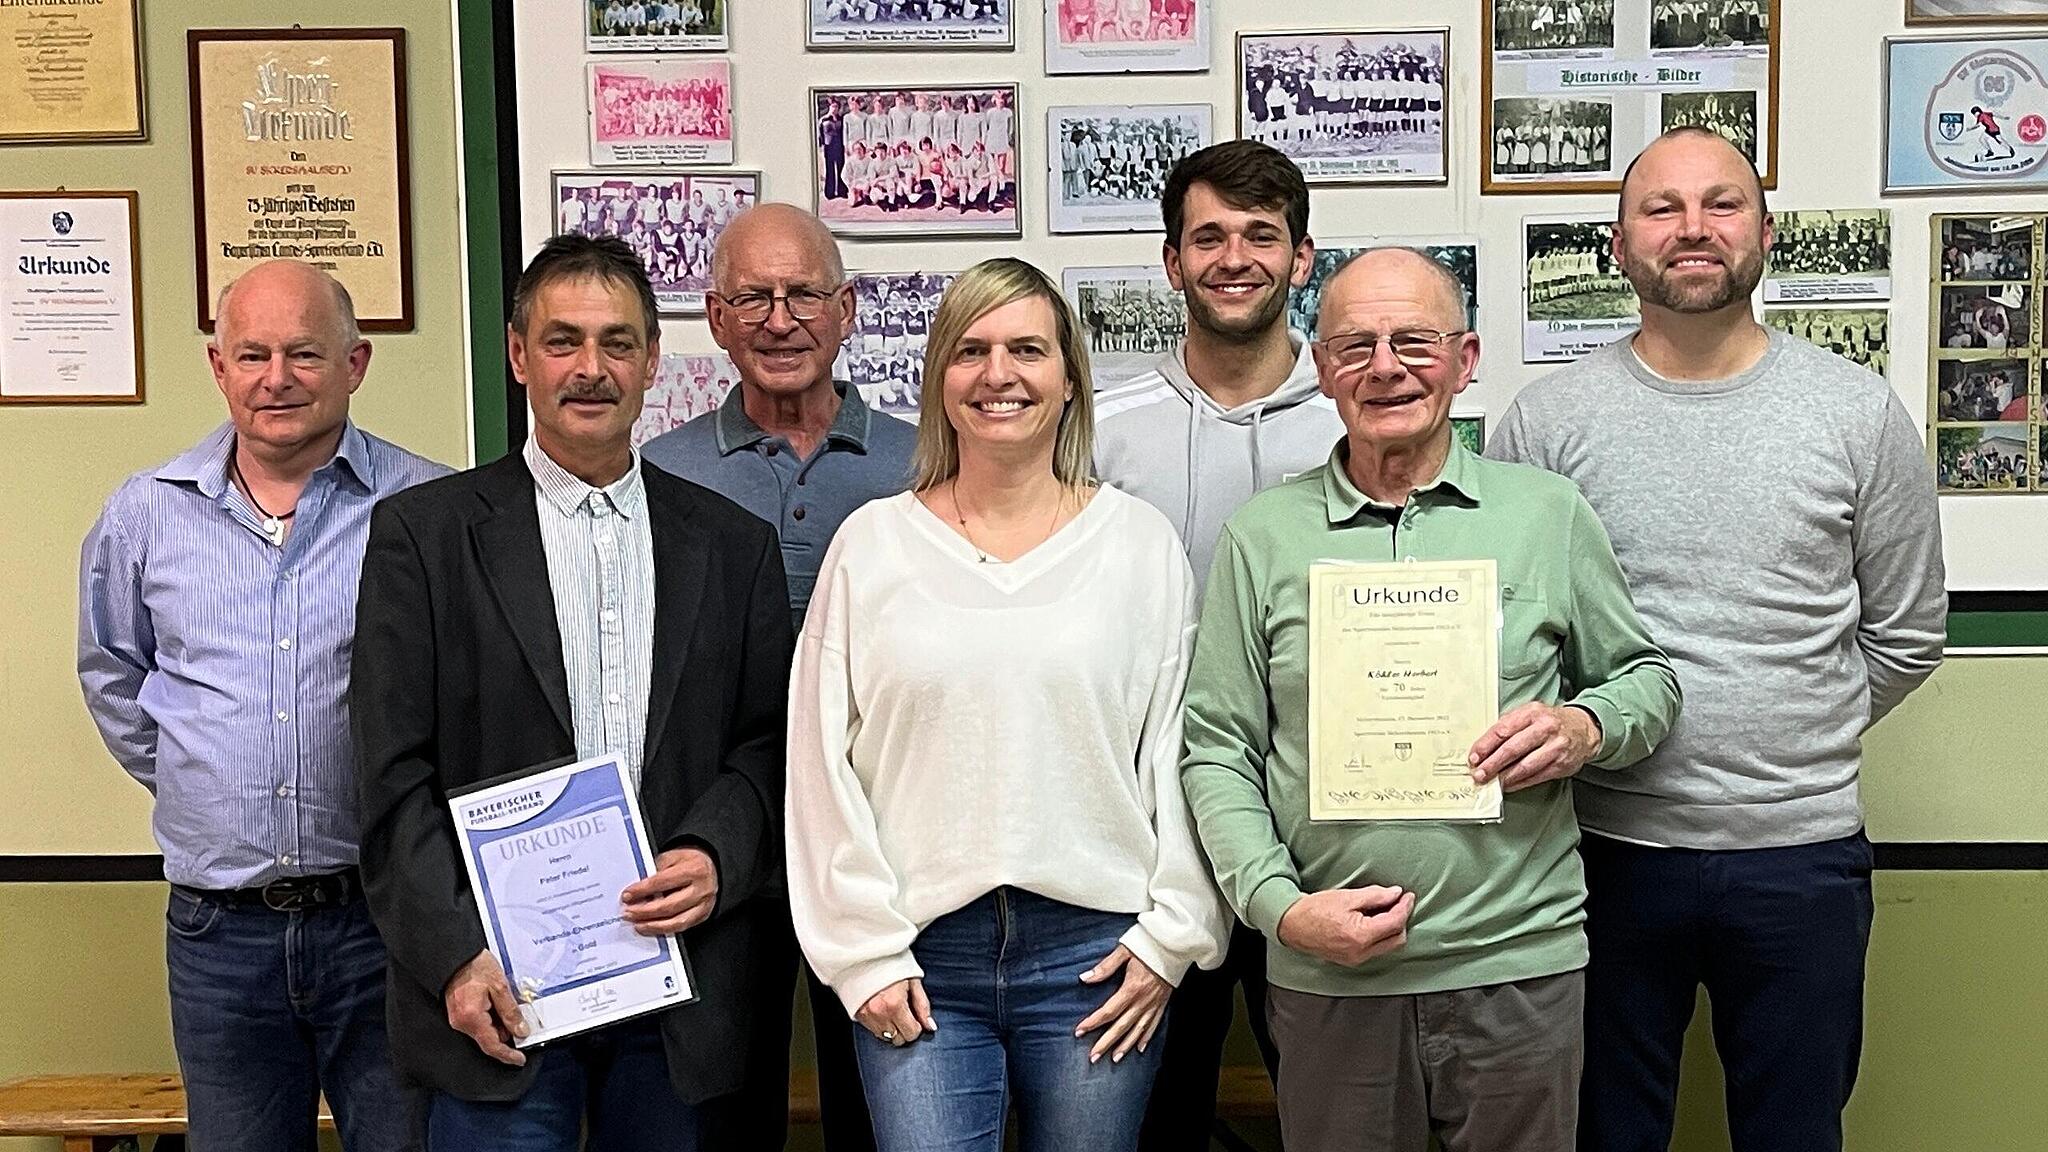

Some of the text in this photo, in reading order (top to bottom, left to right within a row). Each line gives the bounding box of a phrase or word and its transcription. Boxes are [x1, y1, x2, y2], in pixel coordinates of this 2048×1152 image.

[1560, 70, 1638, 85] Historische
[1657, 68, 1701, 81] Bilder
[18, 255, 111, 275] Urkunde
[1354, 585, 1459, 605] Urkunde
[468, 790, 542, 818] BAYERISCHER
[470, 800, 545, 826] FUSSBALL-VERBAND
[499, 815, 607, 861] URKUNDE
